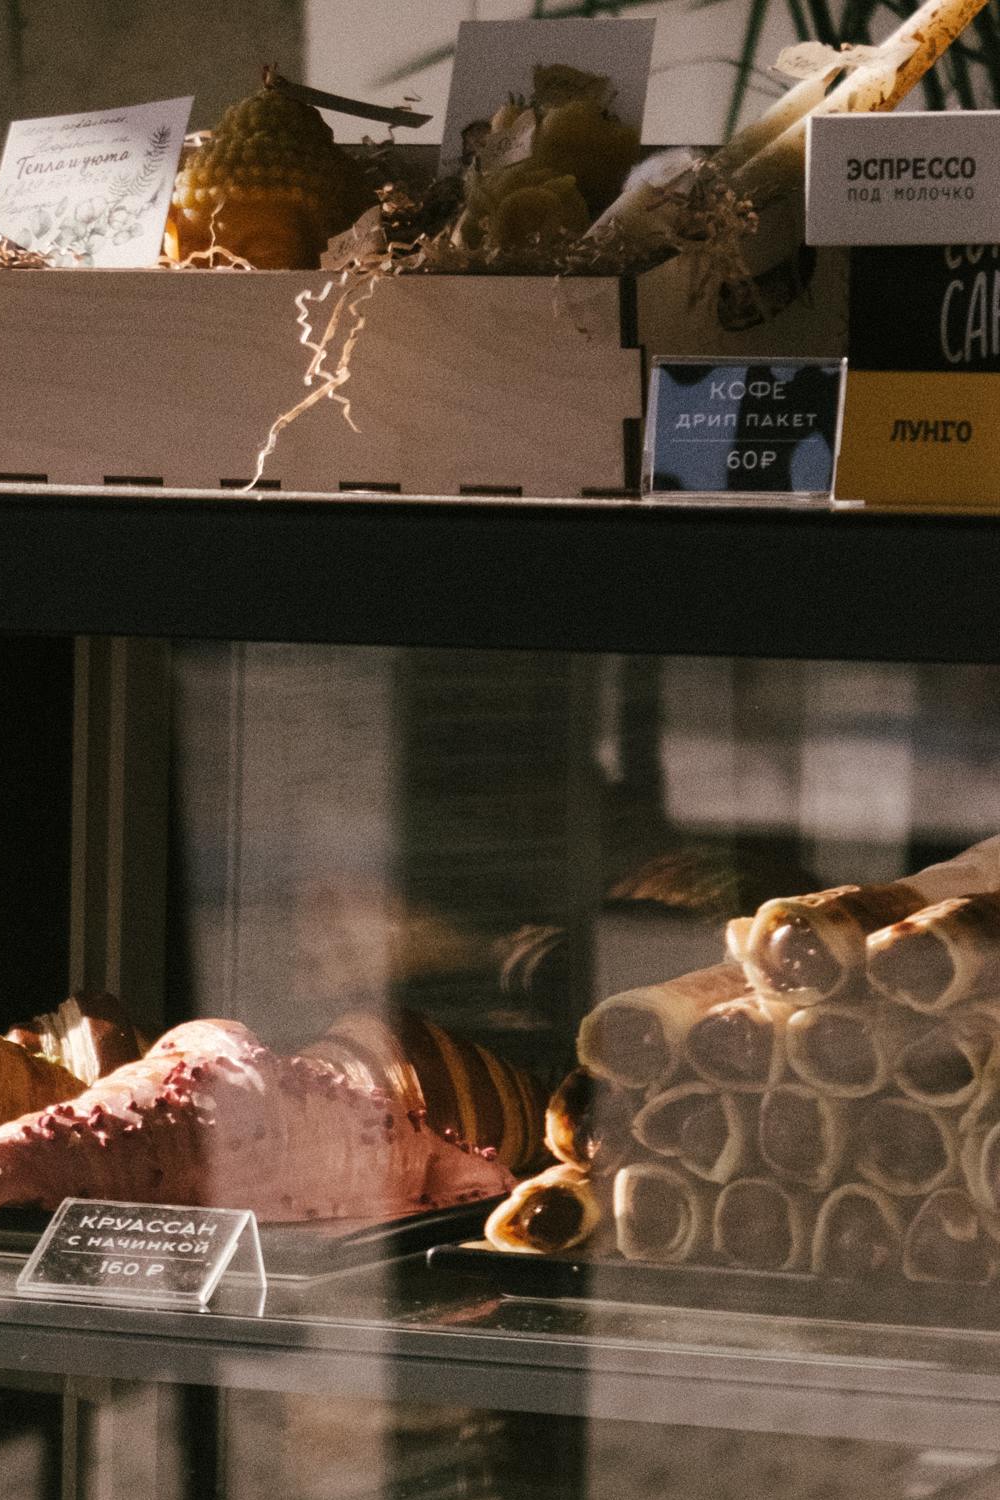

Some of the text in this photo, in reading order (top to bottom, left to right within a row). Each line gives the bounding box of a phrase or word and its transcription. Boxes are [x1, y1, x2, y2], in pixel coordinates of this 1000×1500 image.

[16, 150, 131, 180] Тепла и уюта
[846, 156, 977, 181] ЭСПРЕССО
[709, 380, 788, 400] КОФЕ
[675, 413, 818, 429] ДРИП ПАКЕТ
[890, 418, 973, 444] ЛУНГО
[726, 449, 778, 470] 60₽
[79, 1215, 218, 1237] КРУАССАН
[66, 1235, 211, 1254] С НАЧИНКОЙ
[99, 1260, 140, 1276] 160
